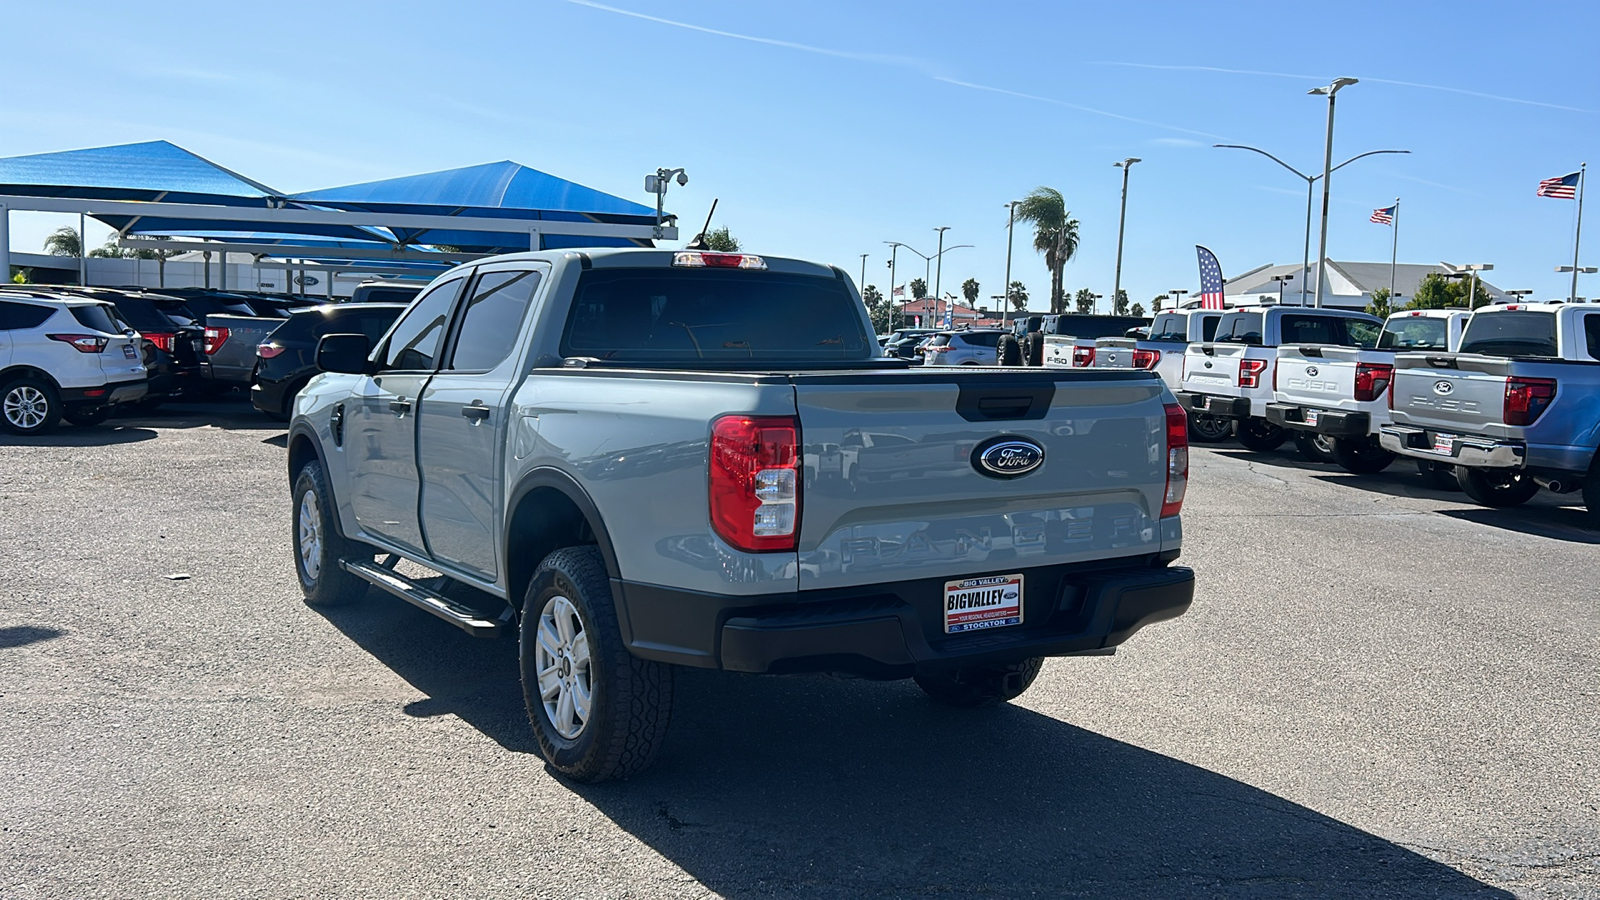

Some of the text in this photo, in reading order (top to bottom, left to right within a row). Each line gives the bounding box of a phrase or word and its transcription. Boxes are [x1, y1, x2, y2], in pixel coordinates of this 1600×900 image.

[1046, 357, 1068, 365] F-150
[997, 448, 1031, 467] Ford
[979, 577, 1005, 585] VALLEY
[947, 589, 1005, 611] BIGVALLEY
[963, 619, 1006, 630] STOCKTON
